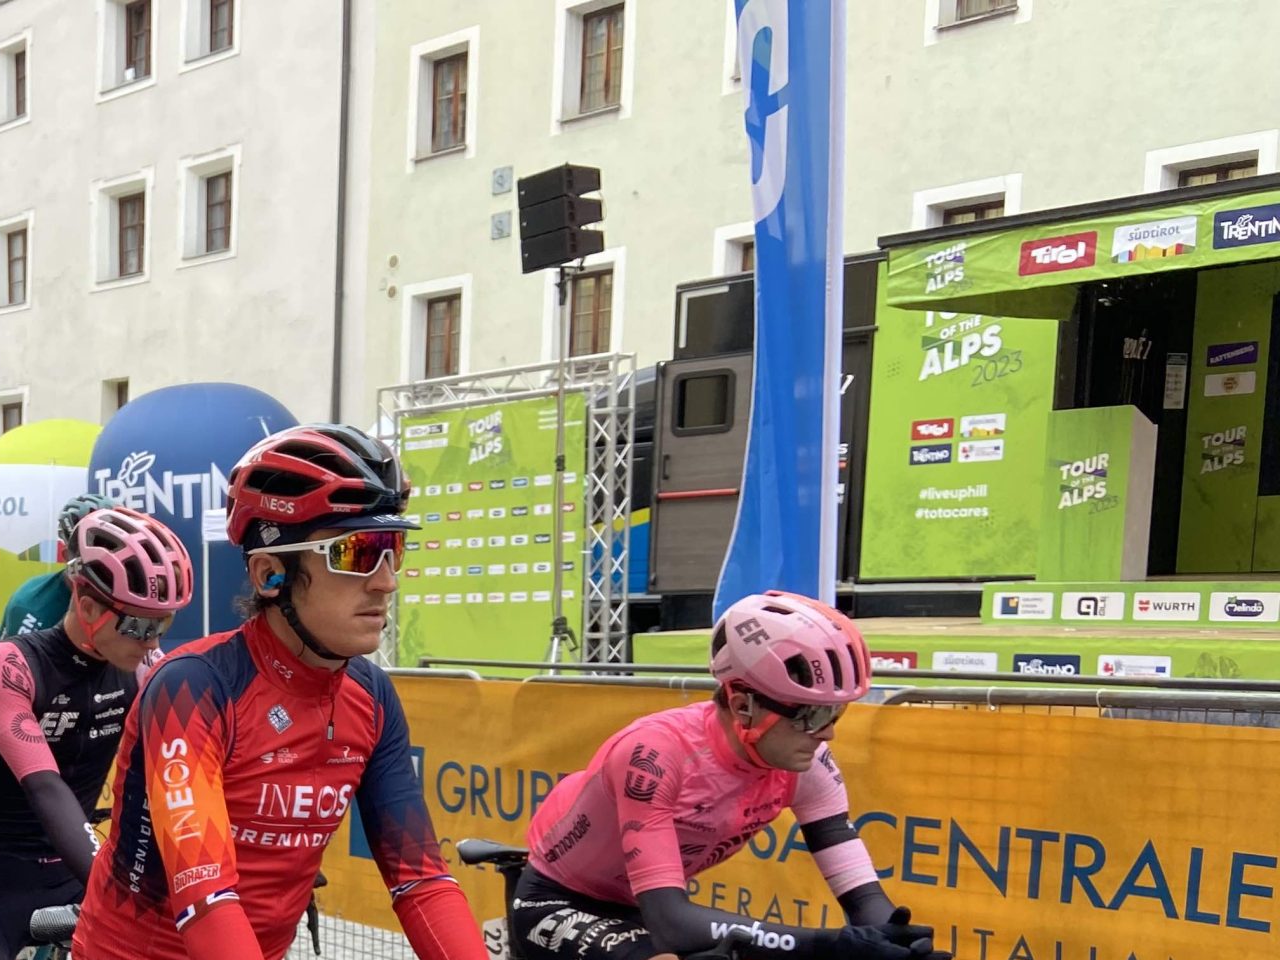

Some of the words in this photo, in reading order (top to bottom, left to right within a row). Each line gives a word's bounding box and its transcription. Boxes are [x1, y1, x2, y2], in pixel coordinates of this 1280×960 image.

[926, 243, 967, 268] TOUR
[1031, 241, 1087, 264] Tirol
[925, 267, 965, 294] ALPS
[940, 326, 956, 339] OF
[959, 315, 982, 331] THE
[919, 324, 1002, 381] ALPS
[971, 351, 1023, 387] 2023
[468, 411, 502, 437] TOUR
[1201, 426, 1247, 448] TOUR
[469, 438, 502, 464] ALPS
[1200, 450, 1245, 474] ALPS
[1060, 453, 1109, 480] TOUR
[95, 462, 229, 518] TRENTIN
[919, 485, 988, 500] #liveuphill
[1058, 481, 1106, 509] ALPS
[260, 496, 294, 514] INEOS
[915, 507, 988, 519] #totacares
[1225, 601, 1263, 613] Melinda
[734, 617, 770, 646] EF
[40, 712, 80, 736] EF
[624, 742, 666, 804] EF
[163, 738, 202, 841] INEOS
[256, 783, 353, 819] INEOS
[437, 761, 569, 822] GRUP
[854, 812, 1277, 933] CENTRALE
[686, 878, 828, 931] PERATI
[601, 927, 650, 952] Rap
[711, 920, 795, 952] whoo
